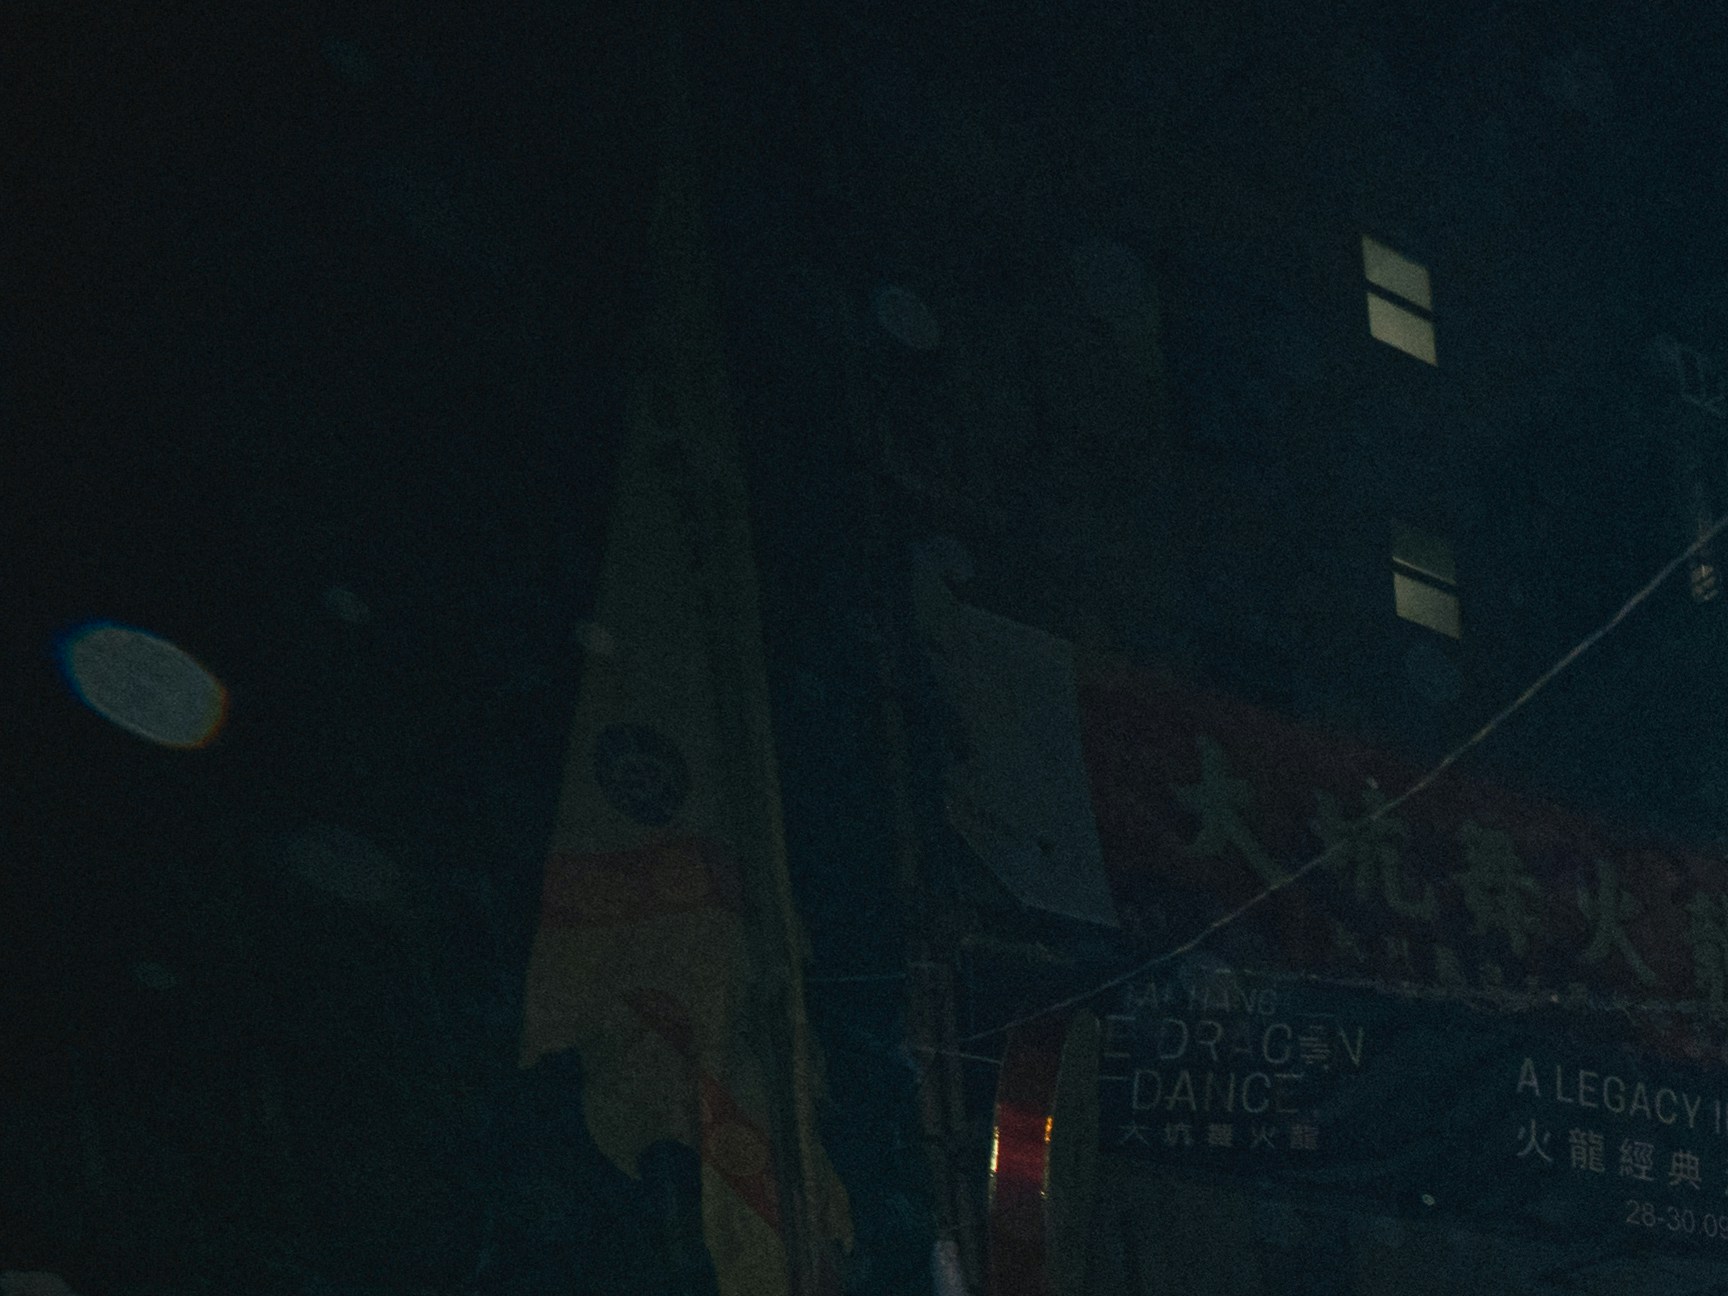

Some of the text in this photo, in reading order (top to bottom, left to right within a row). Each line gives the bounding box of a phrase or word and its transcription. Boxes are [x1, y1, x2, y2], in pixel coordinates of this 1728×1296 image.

[1516, 1057, 1541, 1097] A
[1555, 1064, 1702, 1129] LEGACY
[1516, 1118, 1703, 1192] 火龍經典
